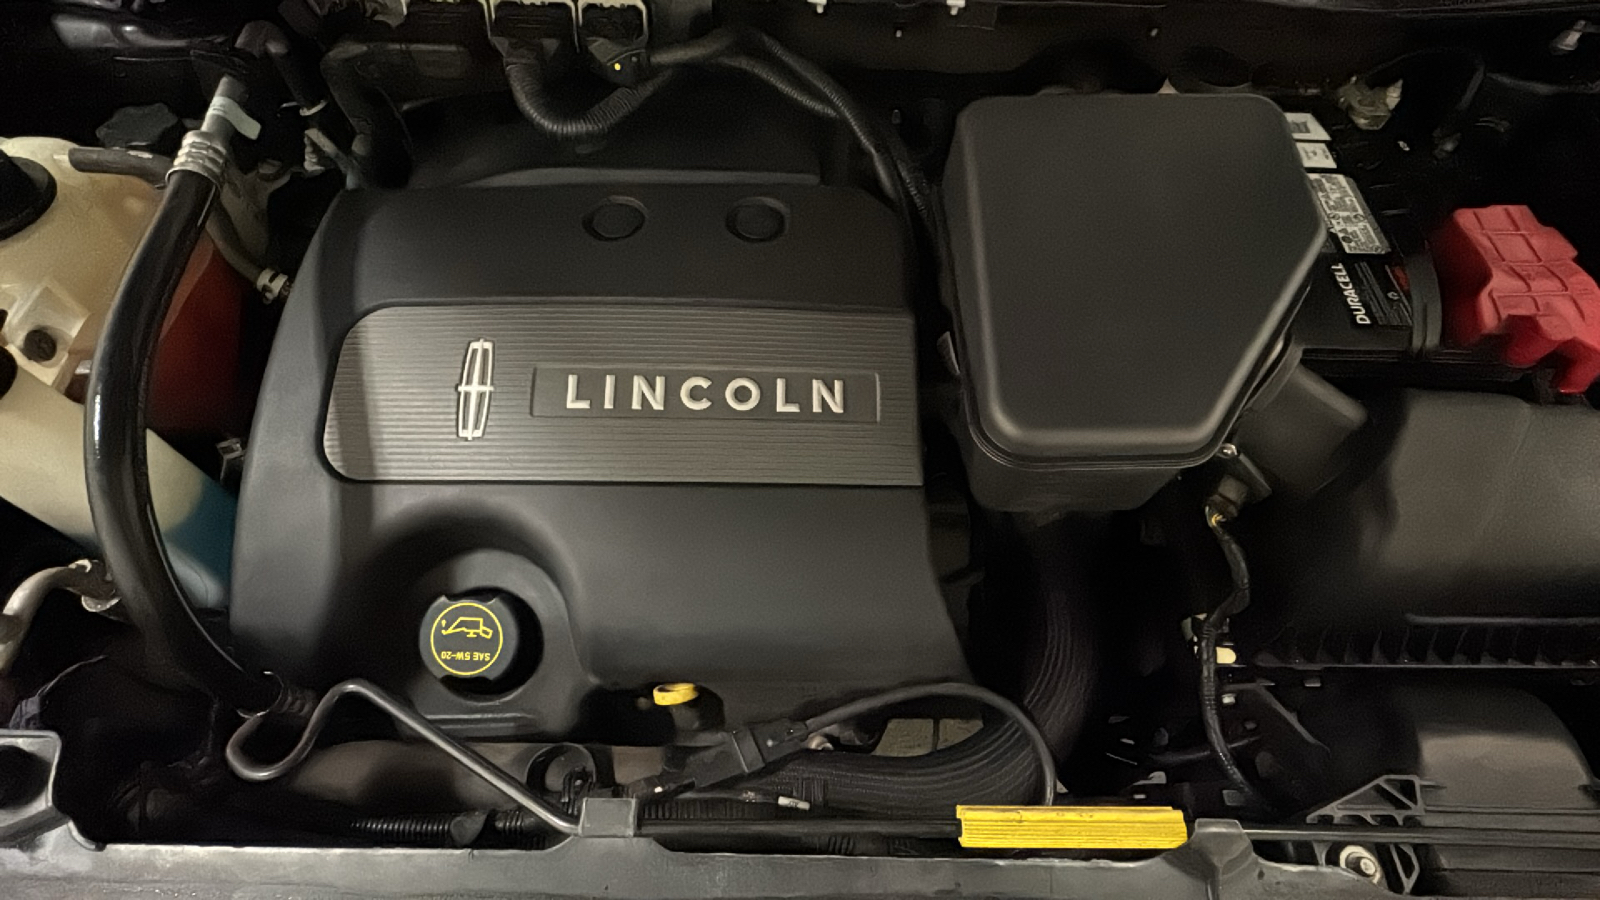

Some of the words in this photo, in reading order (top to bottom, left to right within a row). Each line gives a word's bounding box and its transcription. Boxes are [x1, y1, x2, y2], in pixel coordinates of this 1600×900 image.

[1331, 262, 1371, 324] DURACELL
[566, 374, 844, 413] LINCOLN
[441, 651, 470, 660] 5W-20
[473, 652, 491, 661] SAE
